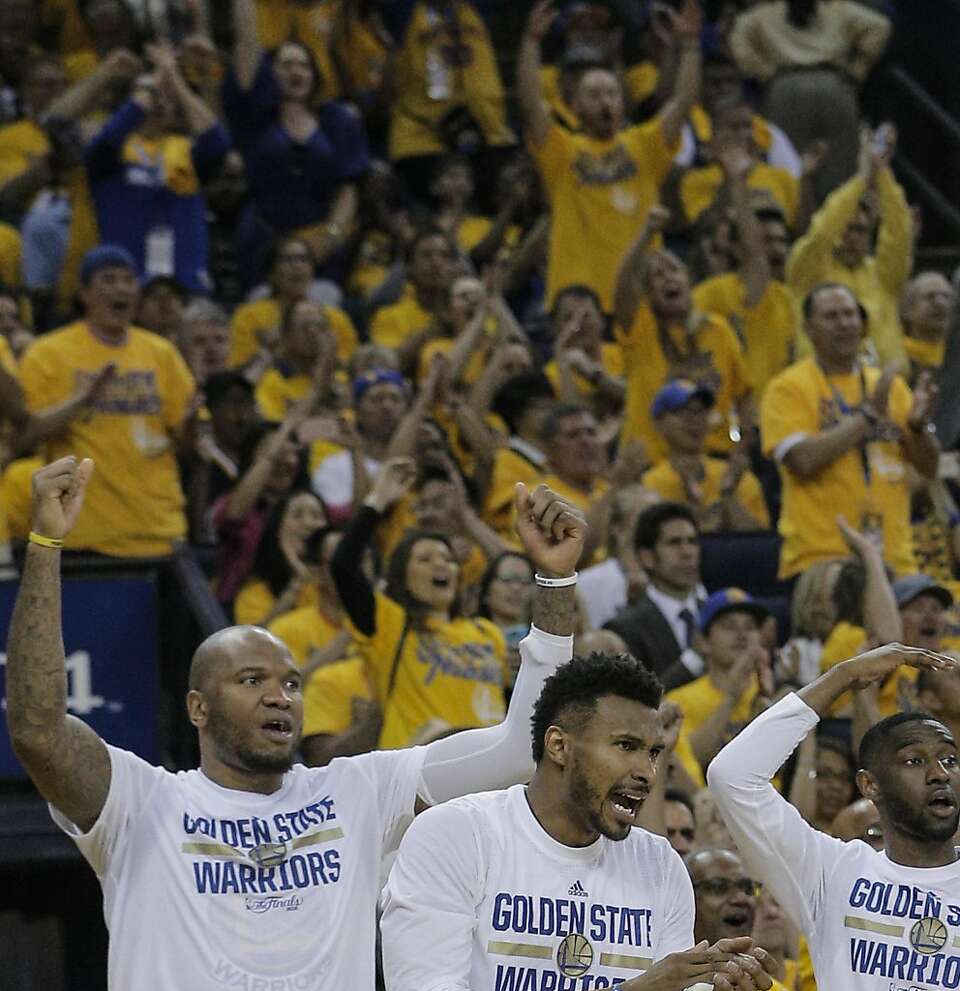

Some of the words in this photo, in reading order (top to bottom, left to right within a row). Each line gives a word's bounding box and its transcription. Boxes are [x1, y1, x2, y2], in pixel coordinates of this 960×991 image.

[273, 795, 337, 843] STATE
[193, 849, 341, 894] WARRIORS
[491, 893, 586, 937] GOLDEN
[590, 903, 652, 947] STATE
[849, 877, 942, 920] GOLDEN
